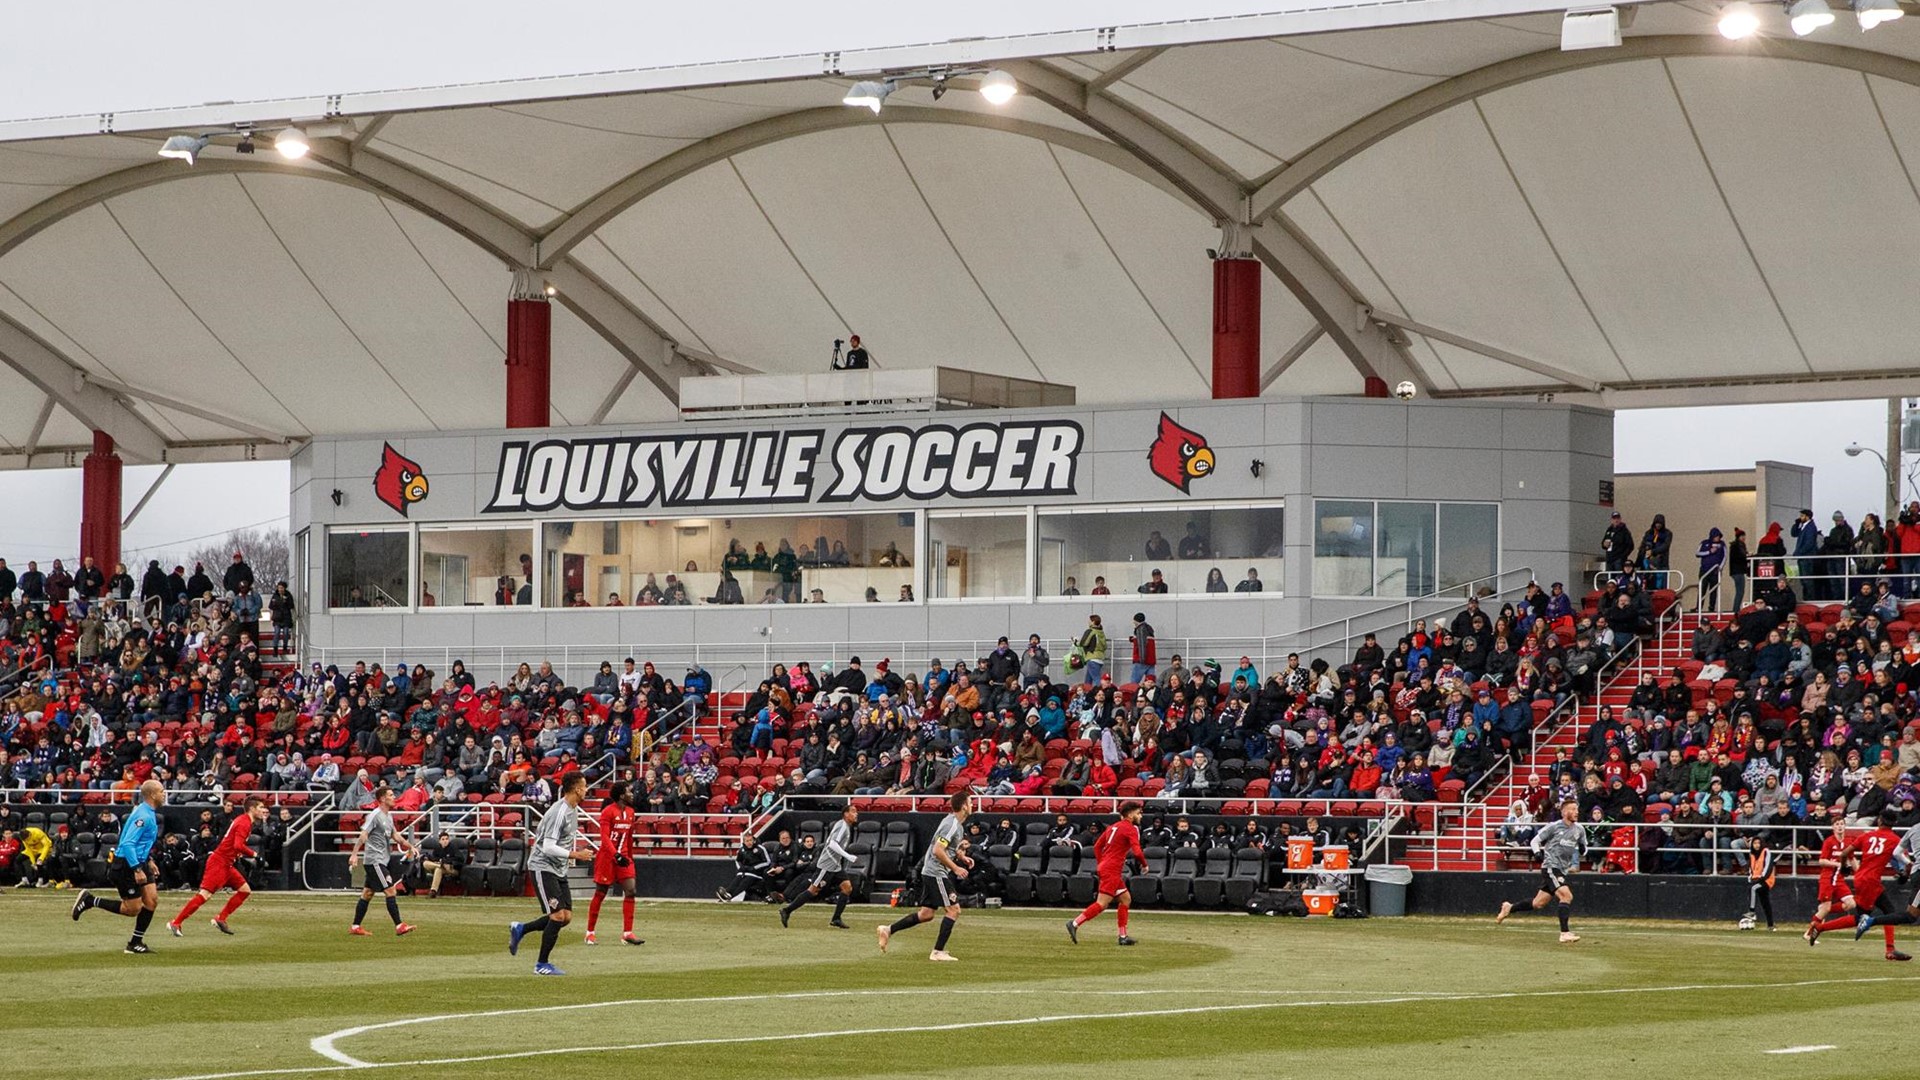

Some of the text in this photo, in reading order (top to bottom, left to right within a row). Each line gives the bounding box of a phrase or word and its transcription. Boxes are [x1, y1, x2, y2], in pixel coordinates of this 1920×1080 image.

[484, 422, 1081, 511] LOUISVILLE SOCCER
[1107, 826, 1118, 844] 7
[1867, 836, 1887, 855] 23
[1310, 897, 1320, 908] G
